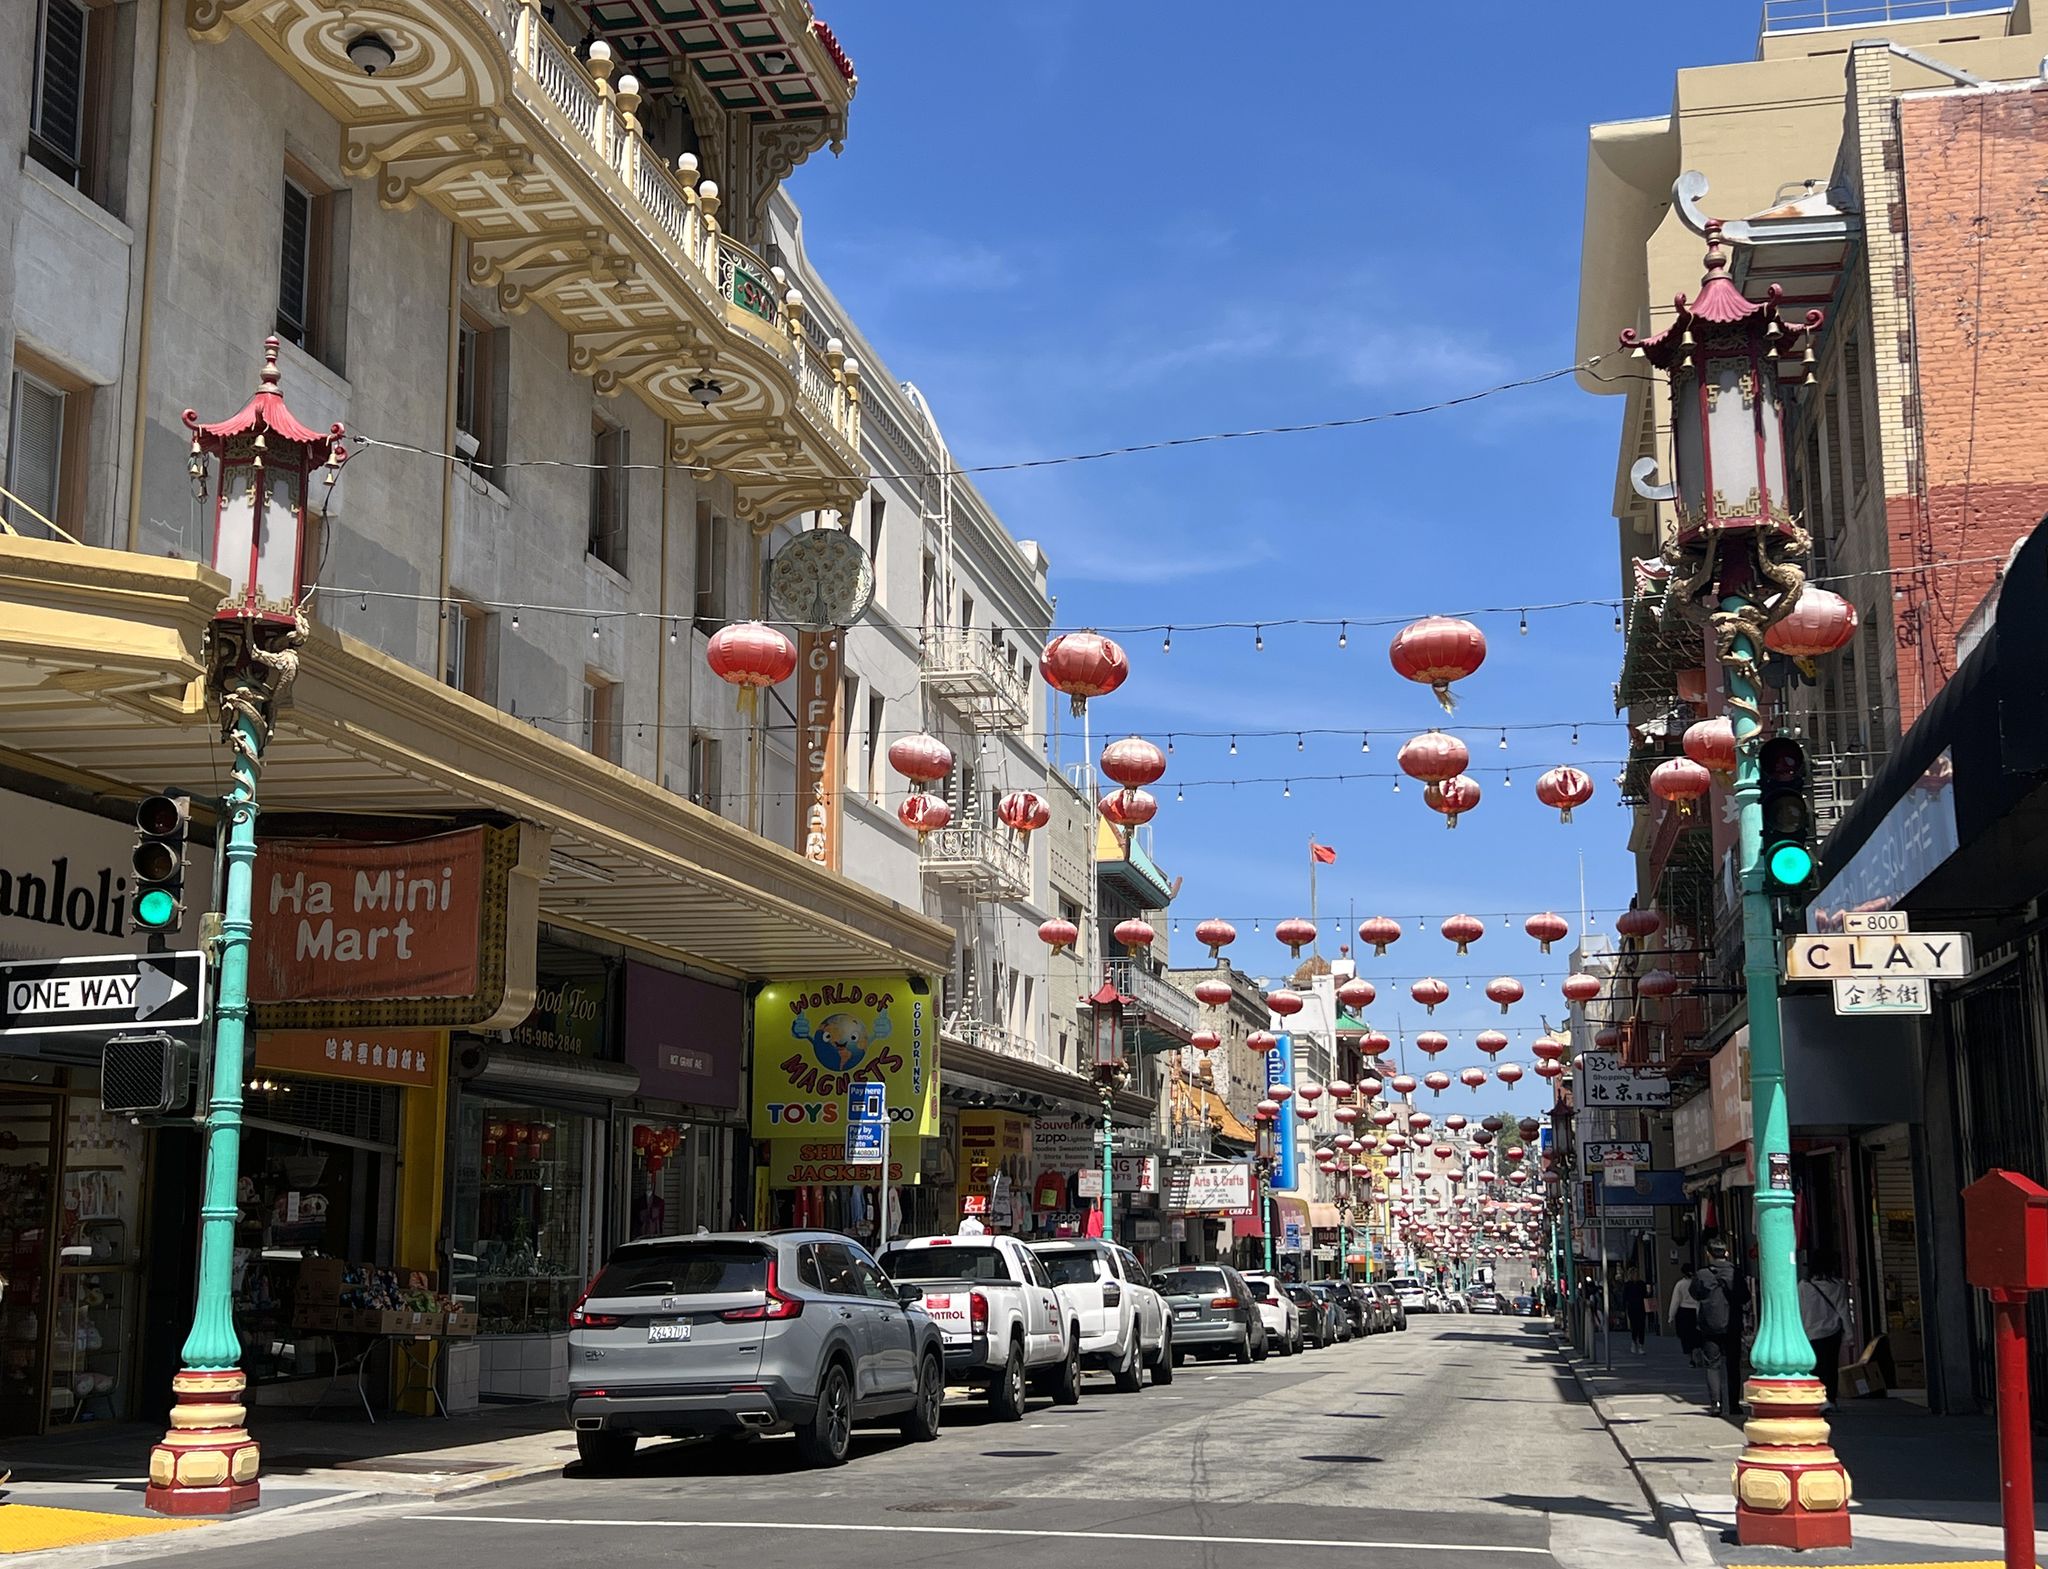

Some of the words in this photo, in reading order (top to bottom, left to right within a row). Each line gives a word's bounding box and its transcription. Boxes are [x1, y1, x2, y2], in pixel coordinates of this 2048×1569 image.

[808, 648, 829, 773] GIFTS
[269, 871, 334, 915] Ha
[353, 866, 452, 913] Mini
[1867, 915, 1899, 930] 800
[296, 917, 415, 962] Mart
[1806, 941, 1952, 970] CLAY
[13, 981, 70, 1011] ONE
[80, 976, 141, 1007] WAY
[536, 981, 569, 1015] ood
[789, 982, 863, 1016] WORLD
[864, 992, 894, 1013] OF
[913, 1002, 922, 1038] COLD
[780, 1046, 904, 1096] MAGNETS
[912, 1040, 922, 1094] DRINKS
[850, 1088, 864, 1097] Pay
[864, 1087, 881, 1095] here
[767, 1103, 839, 1125] TOYS
[849, 1126, 862, 1136] Pay
[862, 1125, 873, 1135] by
[1035, 1133, 1067, 1144] zippo
[972, 1149, 986, 1157] WE
[787, 1163, 903, 1182] JACKETS
[1193, 1176, 1211, 1187] Arts
[1221, 1175, 1244, 1186] Crafts
[968, 1184, 990, 1193] FILM
[1051, 1213, 1081, 1222] zippo
